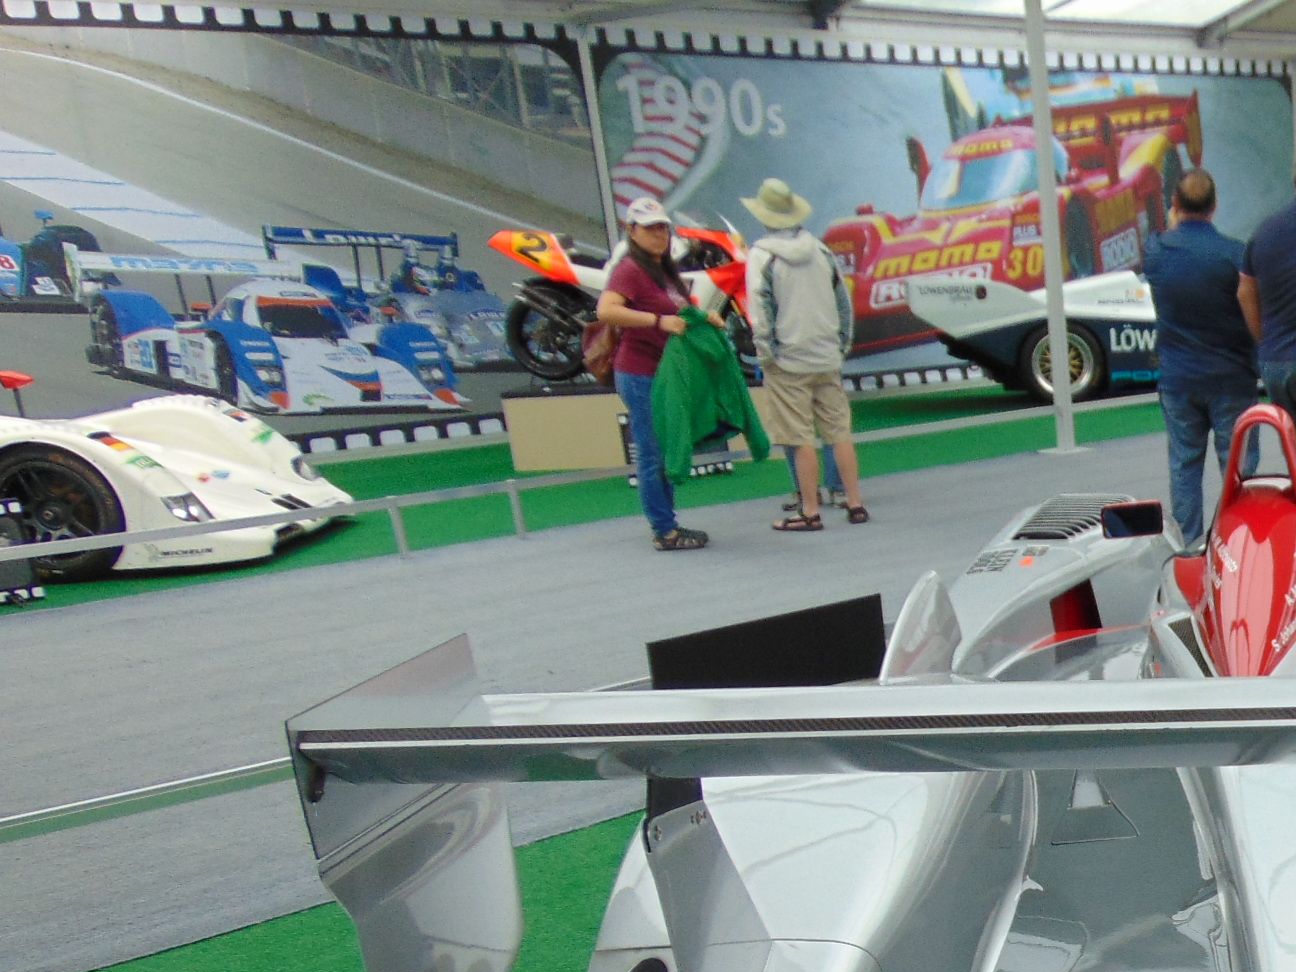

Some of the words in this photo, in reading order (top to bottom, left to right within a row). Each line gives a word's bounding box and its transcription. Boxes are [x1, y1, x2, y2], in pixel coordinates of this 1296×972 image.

[616, 74, 786, 136] 1990s
[520, 232, 548, 263] 2
[873, 240, 1004, 279] momo
[1007, 246, 1043, 279] 30
